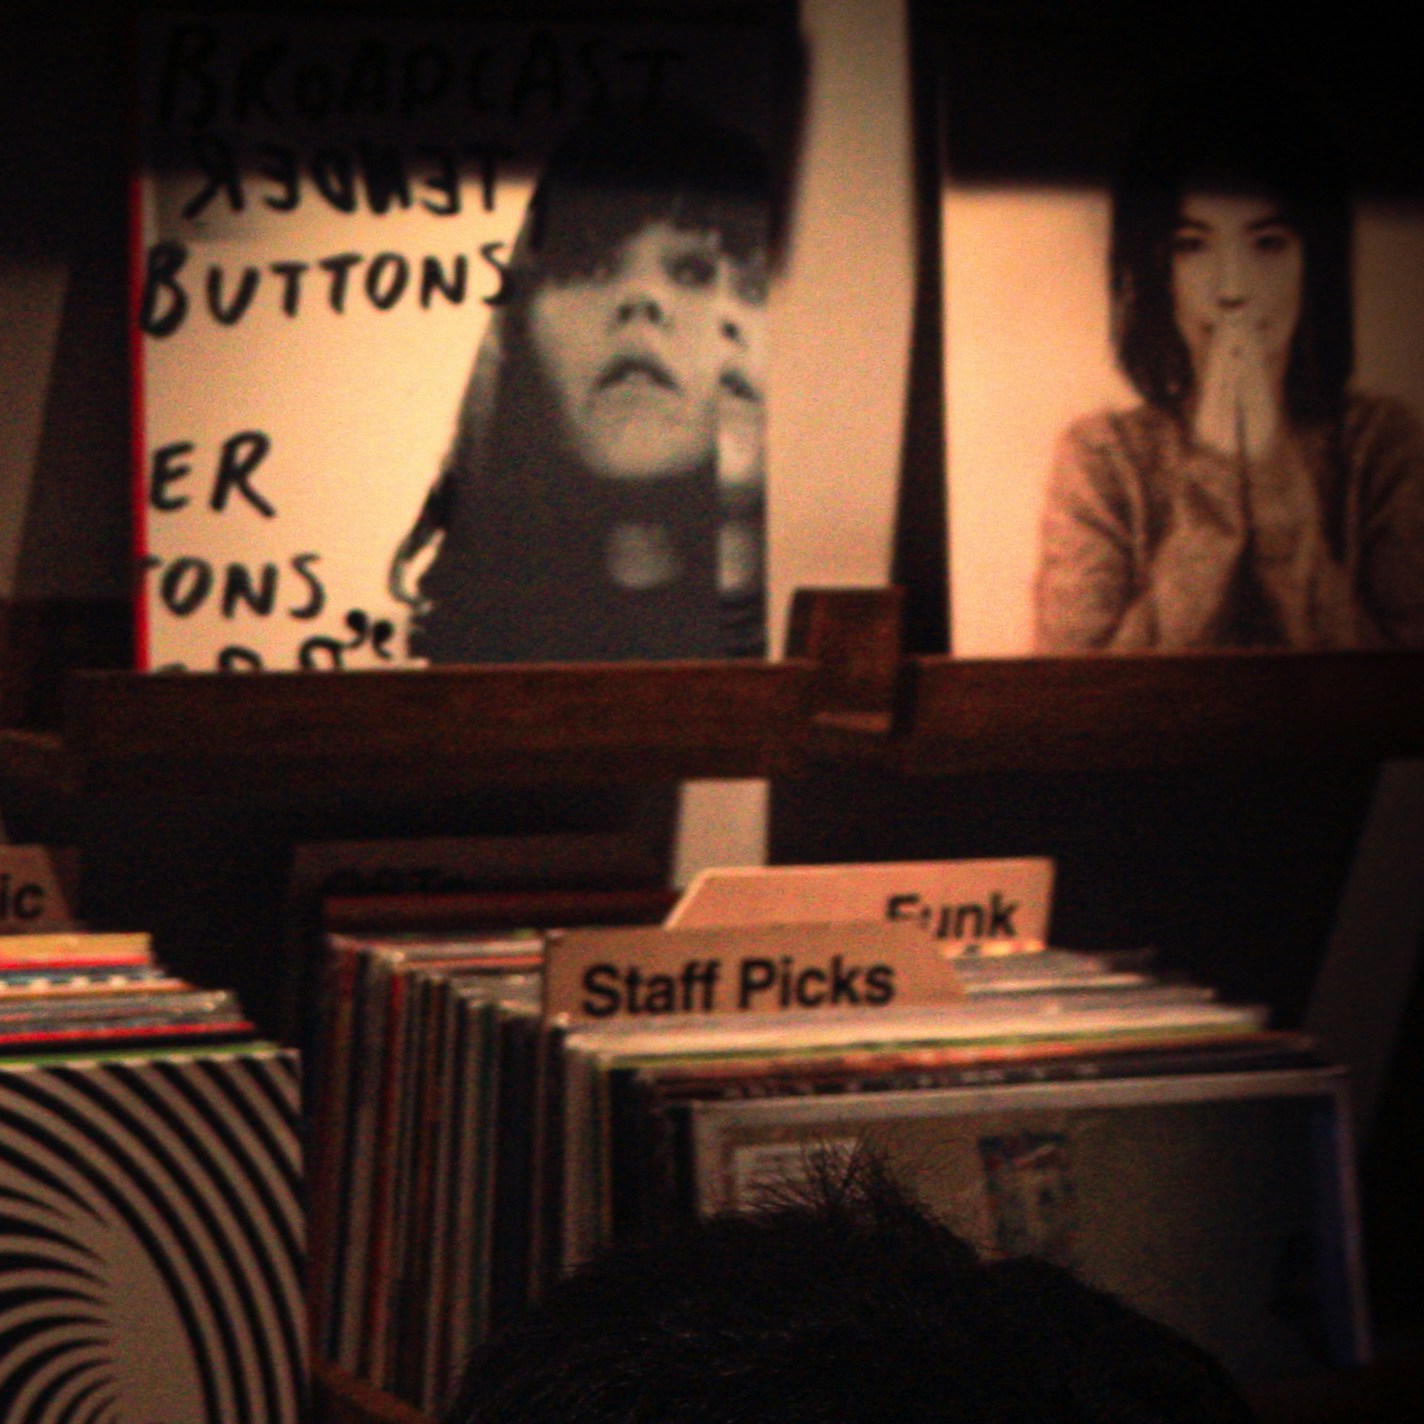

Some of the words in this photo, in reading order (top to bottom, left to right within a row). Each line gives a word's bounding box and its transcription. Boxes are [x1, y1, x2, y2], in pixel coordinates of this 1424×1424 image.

[138, 240, 512, 340] BUTTONS
[582, 961, 720, 1018] Staff
[740, 954, 894, 1010] Picks
